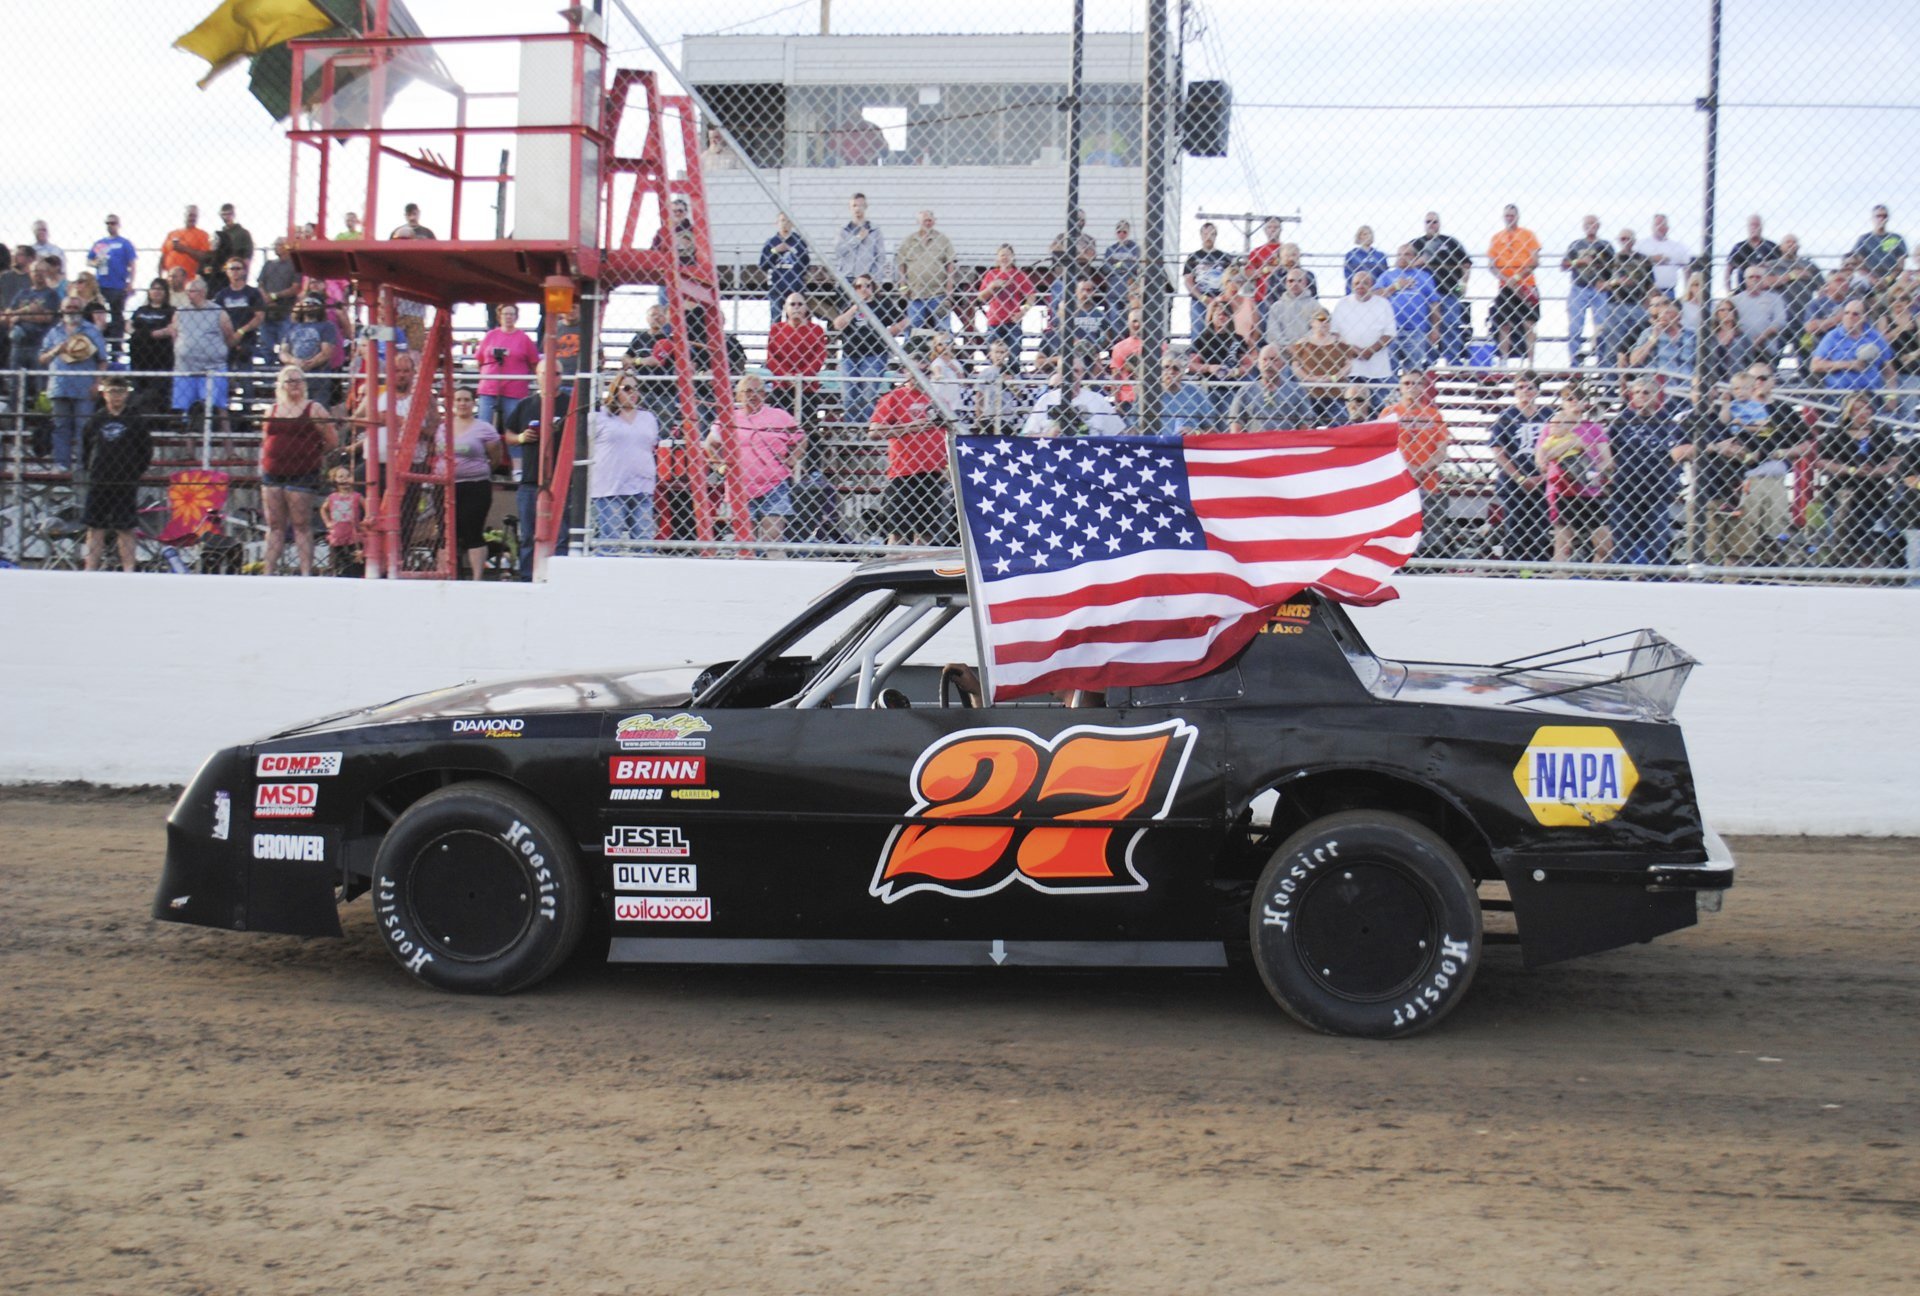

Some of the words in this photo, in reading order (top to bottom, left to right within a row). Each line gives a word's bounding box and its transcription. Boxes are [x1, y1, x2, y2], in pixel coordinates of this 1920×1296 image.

[1276, 604, 1312, 618] ARTS
[452, 719, 525, 732] DIAMOND
[261, 756, 321, 771] COMP
[616, 761, 699, 779] BRINN
[1536, 752, 1618, 799] NAPA
[259, 785, 314, 805] MSD
[609, 789, 663, 800] MOROSO
[253, 834, 324, 861] CROWER
[606, 828, 687, 847] JESEL
[500, 820, 559, 920] Hoosier
[618, 867, 690, 883] OLIVER
[1263, 840, 1338, 933] Hoosier
[617, 898, 709, 919] wilwood
[378, 875, 434, 973] Hoosier
[1393, 933, 1468, 1026] Hoosier
